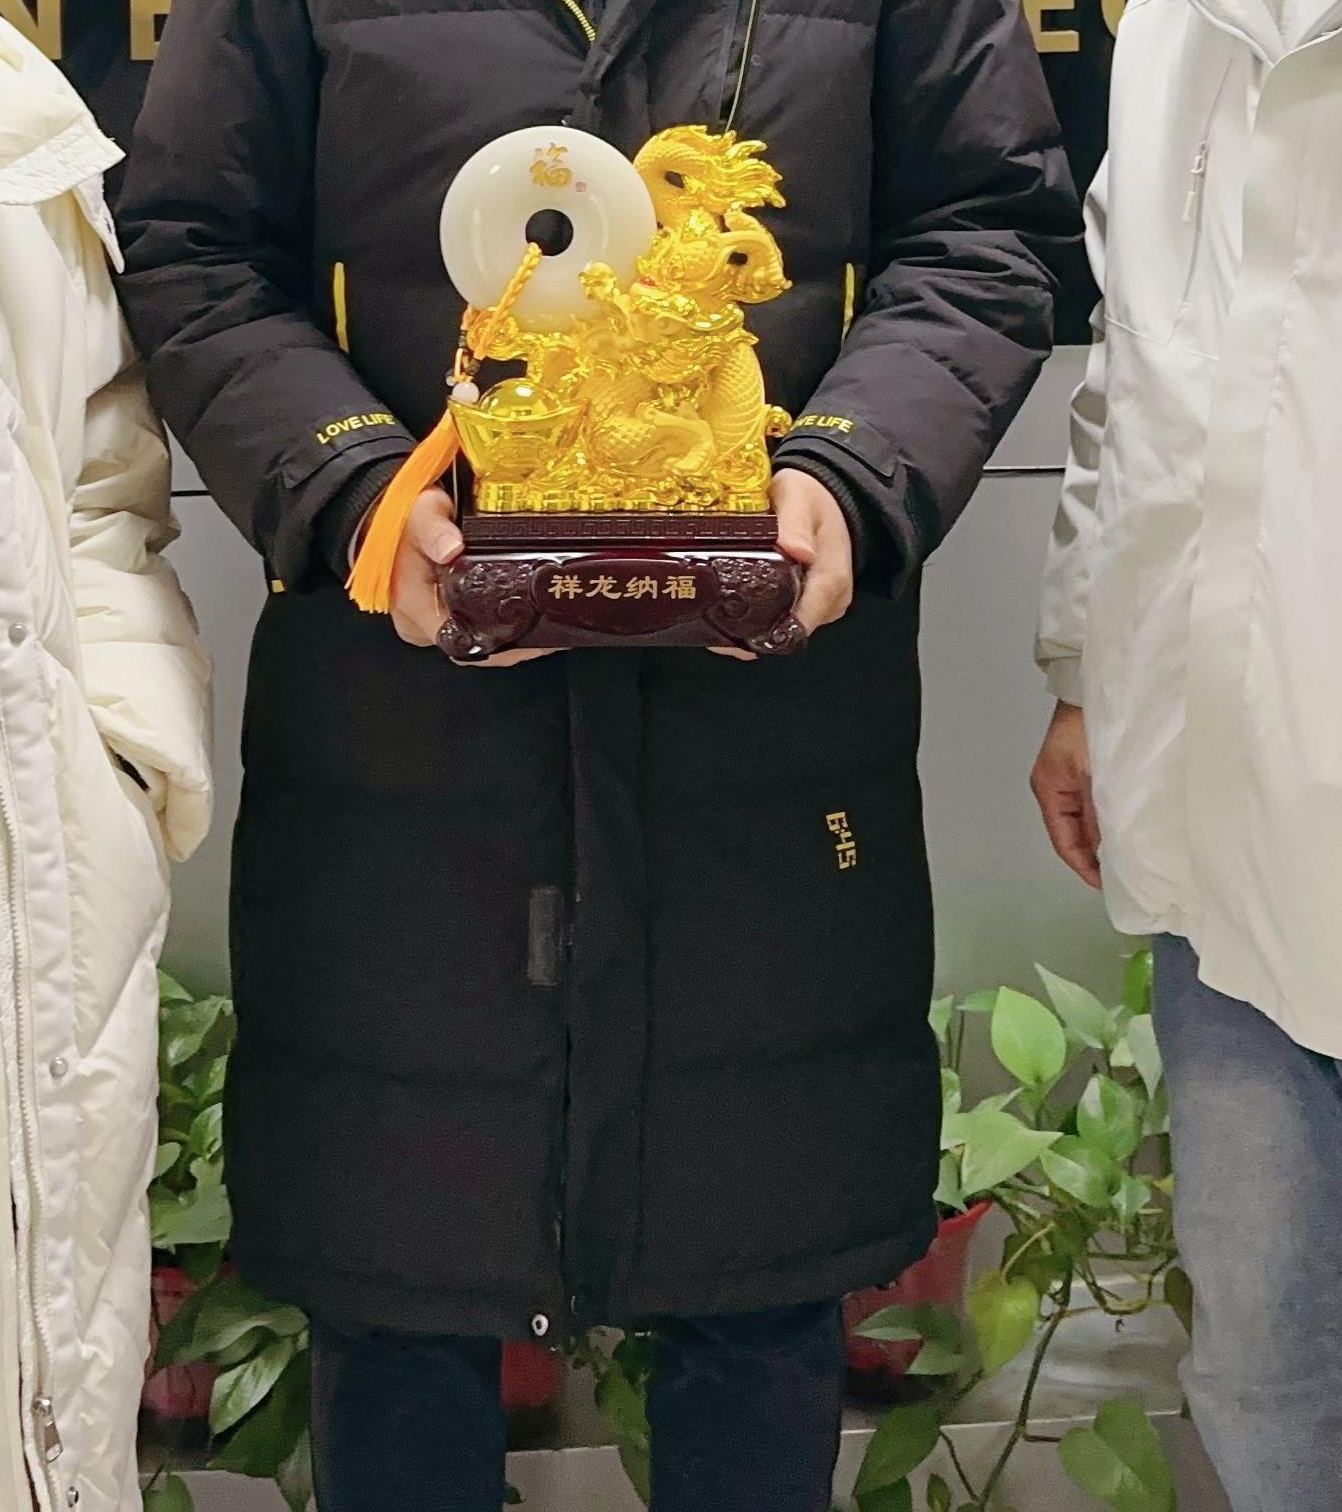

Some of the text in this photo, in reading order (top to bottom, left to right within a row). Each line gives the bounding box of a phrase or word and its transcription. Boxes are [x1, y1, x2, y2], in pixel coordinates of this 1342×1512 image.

[317, 413, 395, 444] LOVE LIFE
[817, 416, 854, 433] LIFE
[548, 574, 697, 600] 祥龙纳福
